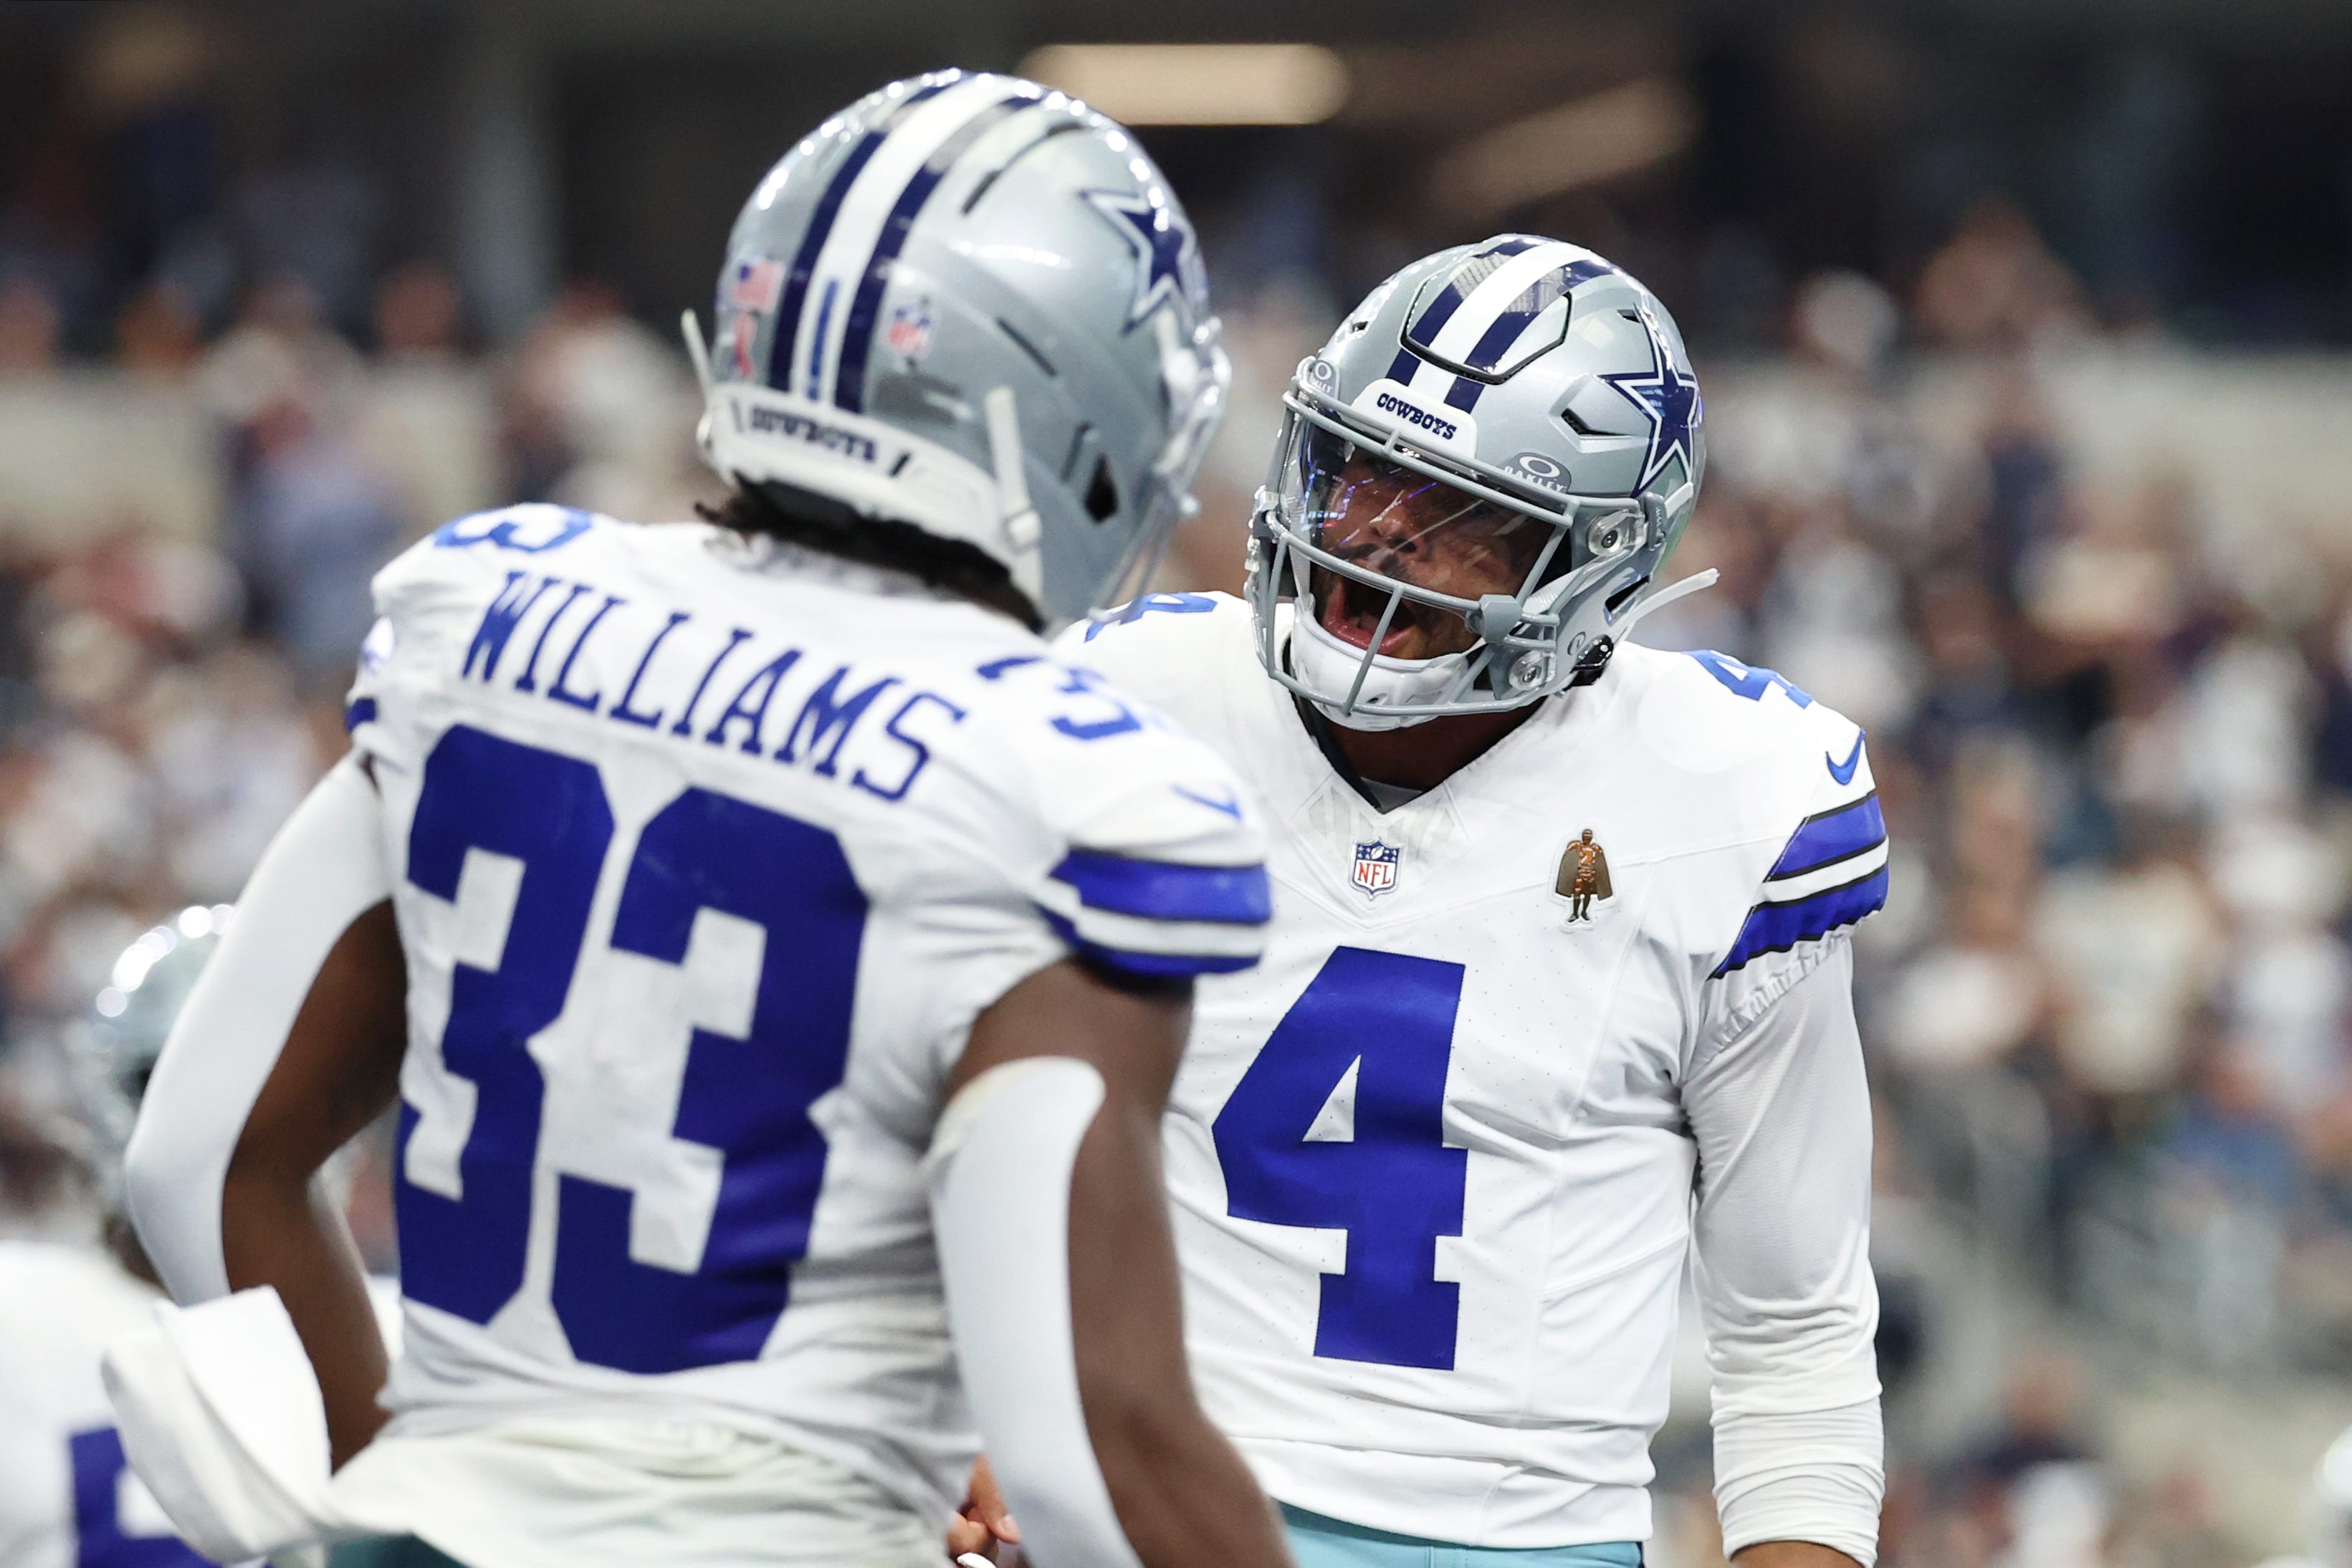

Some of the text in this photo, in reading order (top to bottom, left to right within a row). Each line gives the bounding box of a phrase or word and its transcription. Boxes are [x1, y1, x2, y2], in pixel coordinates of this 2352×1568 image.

[1377, 393, 1457, 440] COWBOYS
[1504, 466, 1564, 492] OAKLEY
[461, 570, 967, 802] WILLIAMS
[1357, 862, 1391, 887] NFL
[390, 722, 871, 1375] 33
[1211, 945, 1468, 1372] 4
